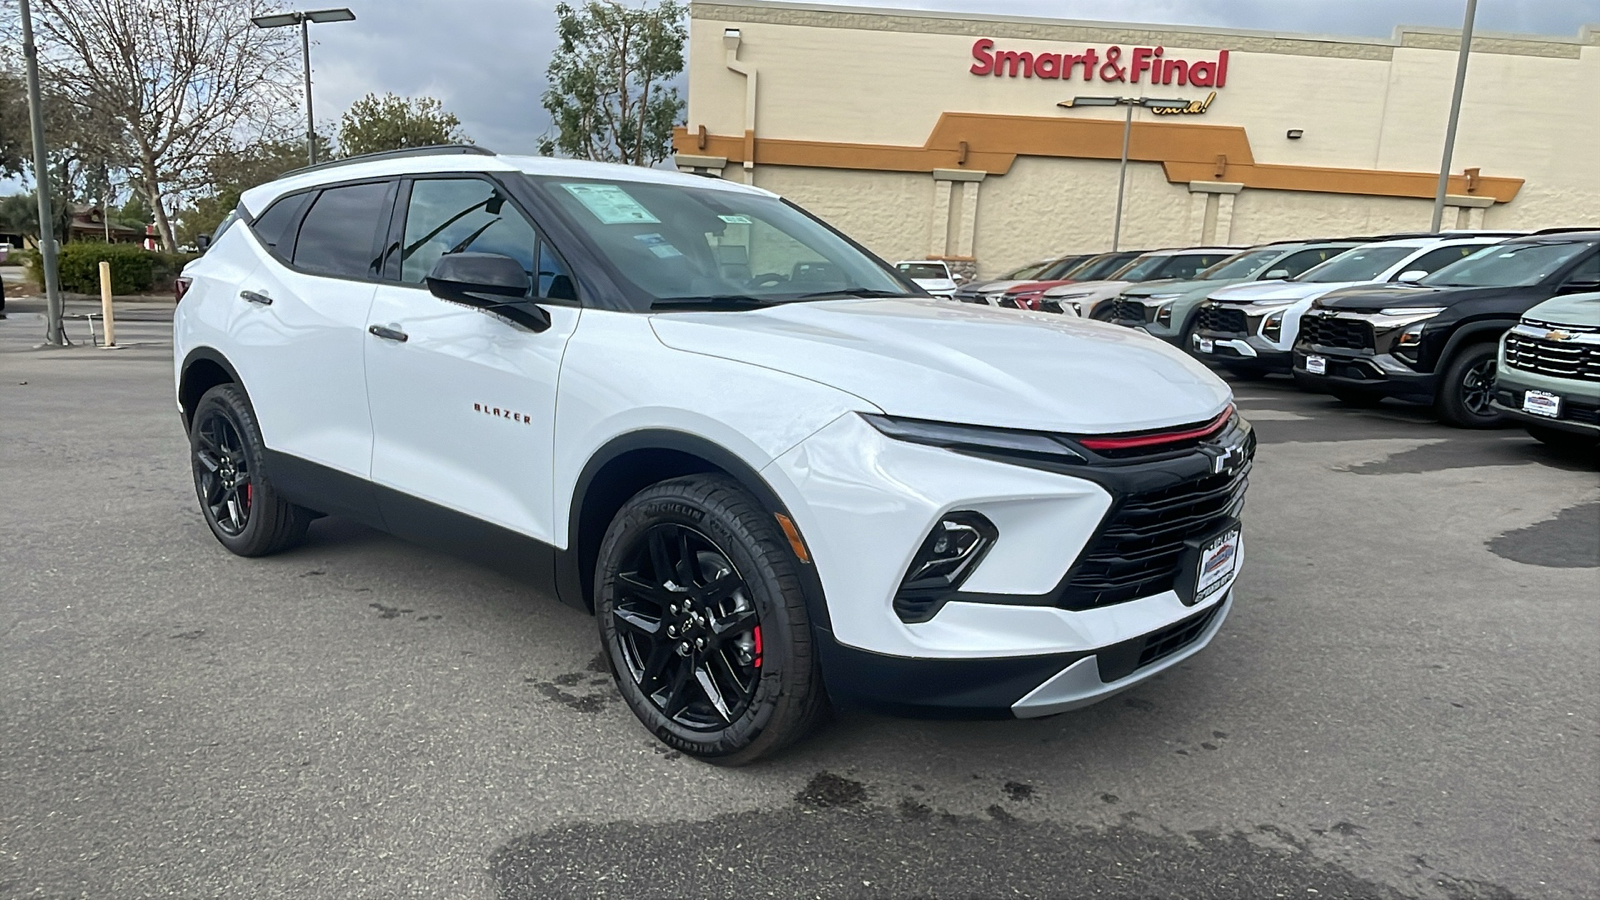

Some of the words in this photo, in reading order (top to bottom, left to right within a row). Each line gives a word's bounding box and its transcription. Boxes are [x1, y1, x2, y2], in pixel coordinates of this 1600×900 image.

[970, 38, 1229, 88] Smart&Final
[474, 403, 531, 425] BLAZER
[647, 503, 702, 520] MICHELIN
